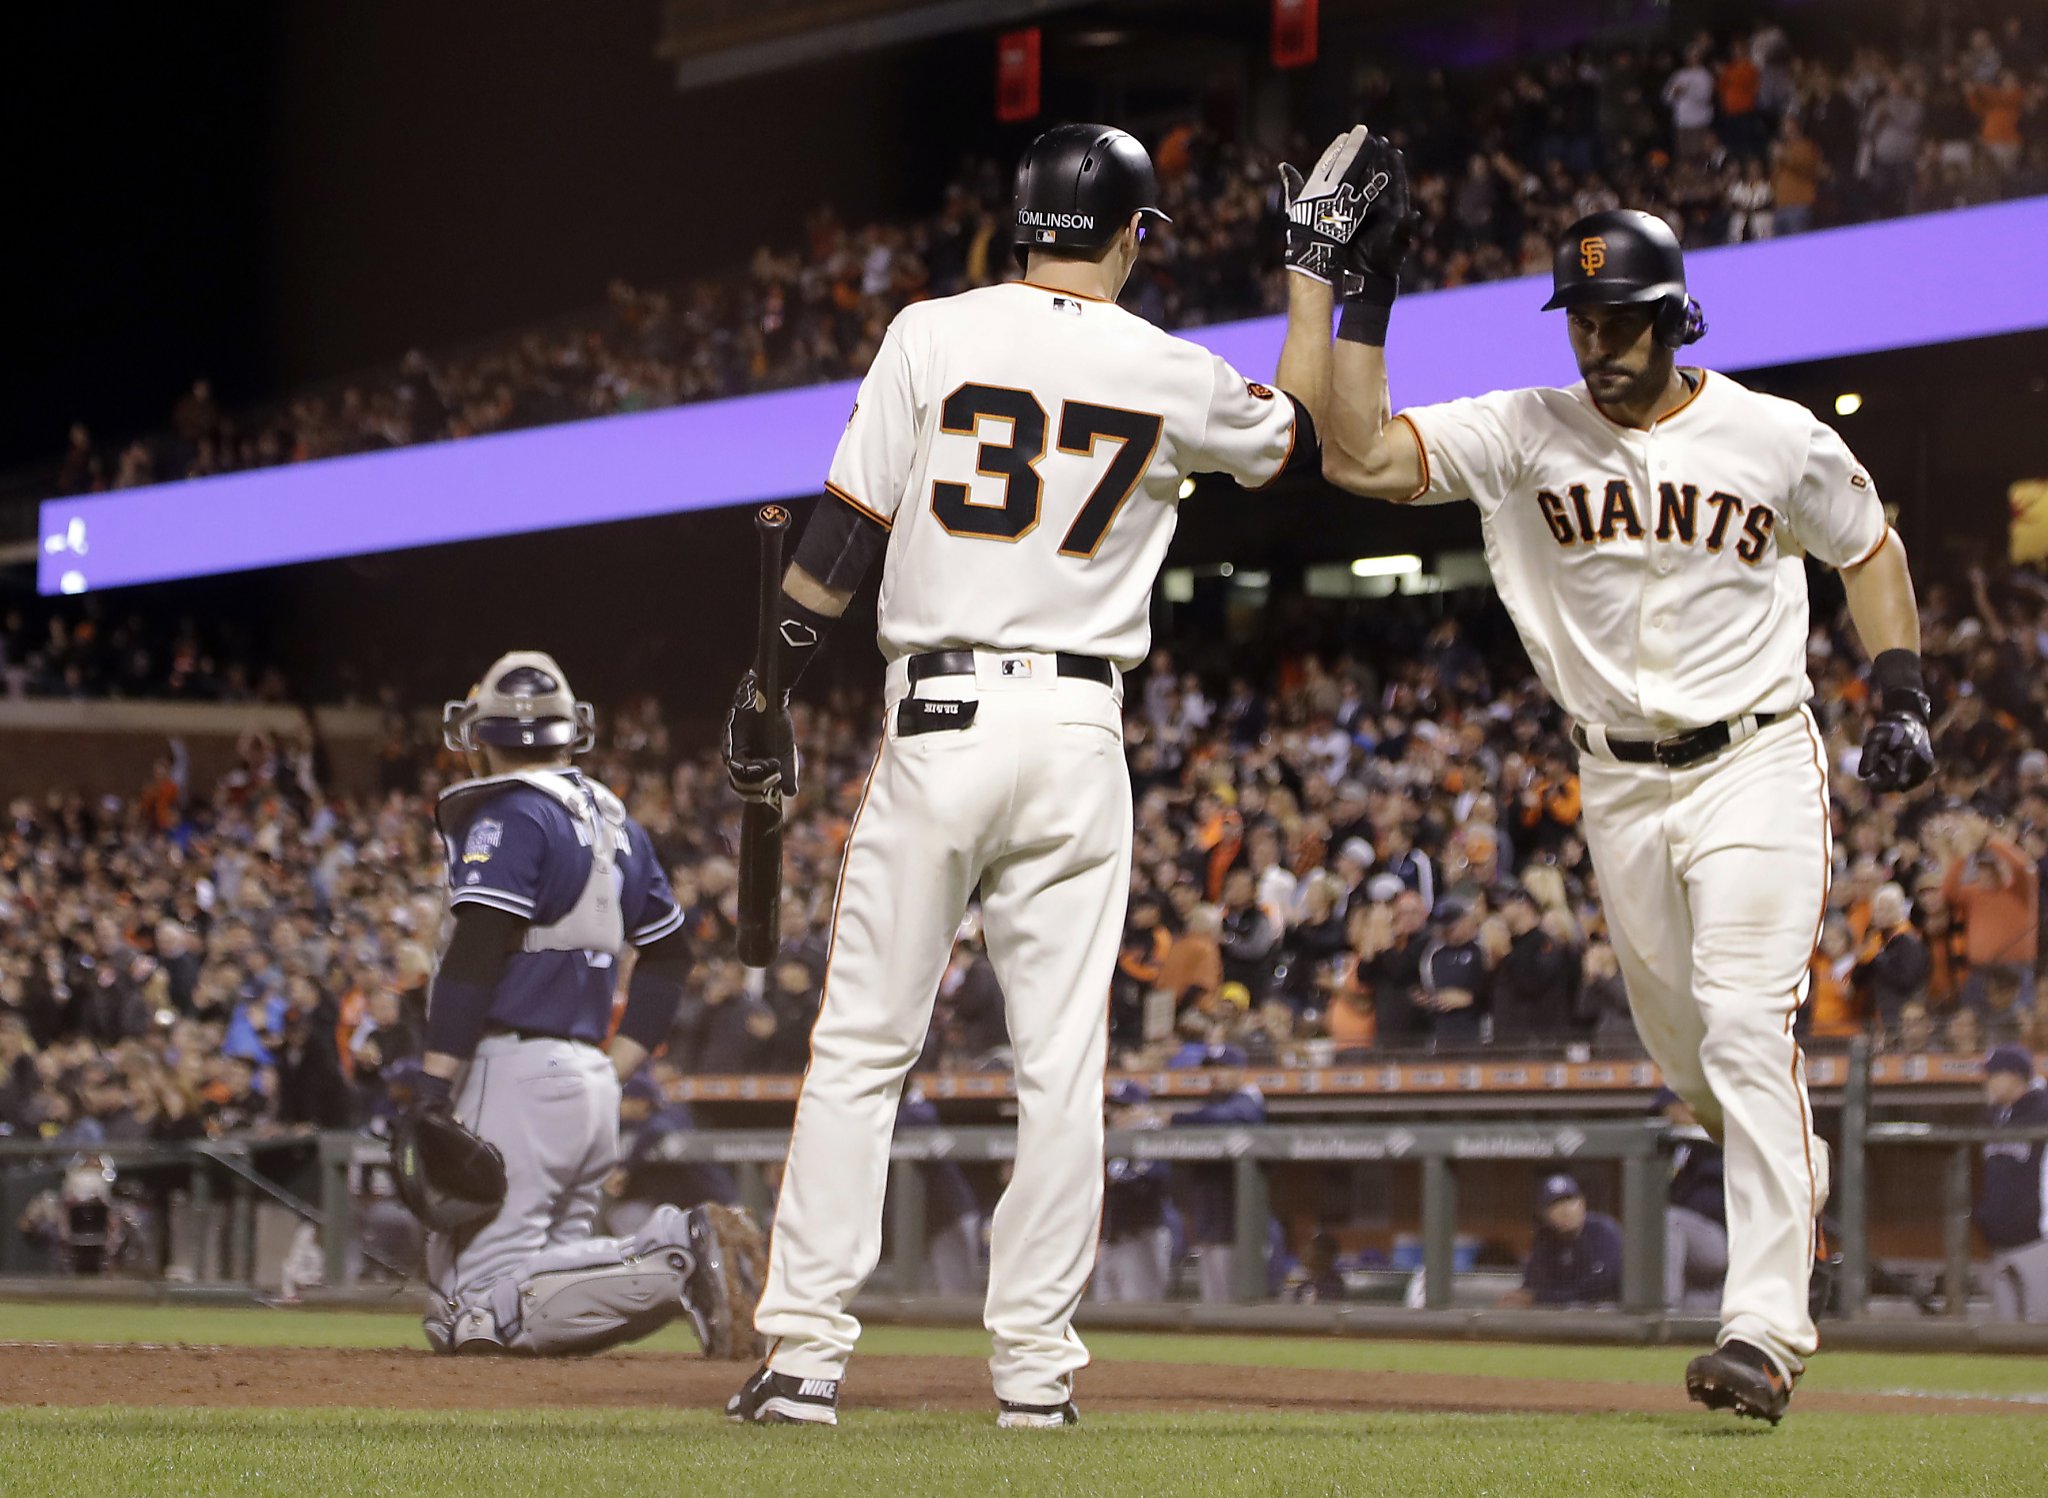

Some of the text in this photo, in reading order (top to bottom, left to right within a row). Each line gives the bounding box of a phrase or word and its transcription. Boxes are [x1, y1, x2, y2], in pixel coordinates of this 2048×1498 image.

[1018, 210, 1094, 230] TOMLINSON
[1581, 236, 1607, 277] SF
[929, 381, 1165, 560] 37
[1537, 479, 1775, 566] GIANTS
[798, 1379, 837, 1399] NIKE
